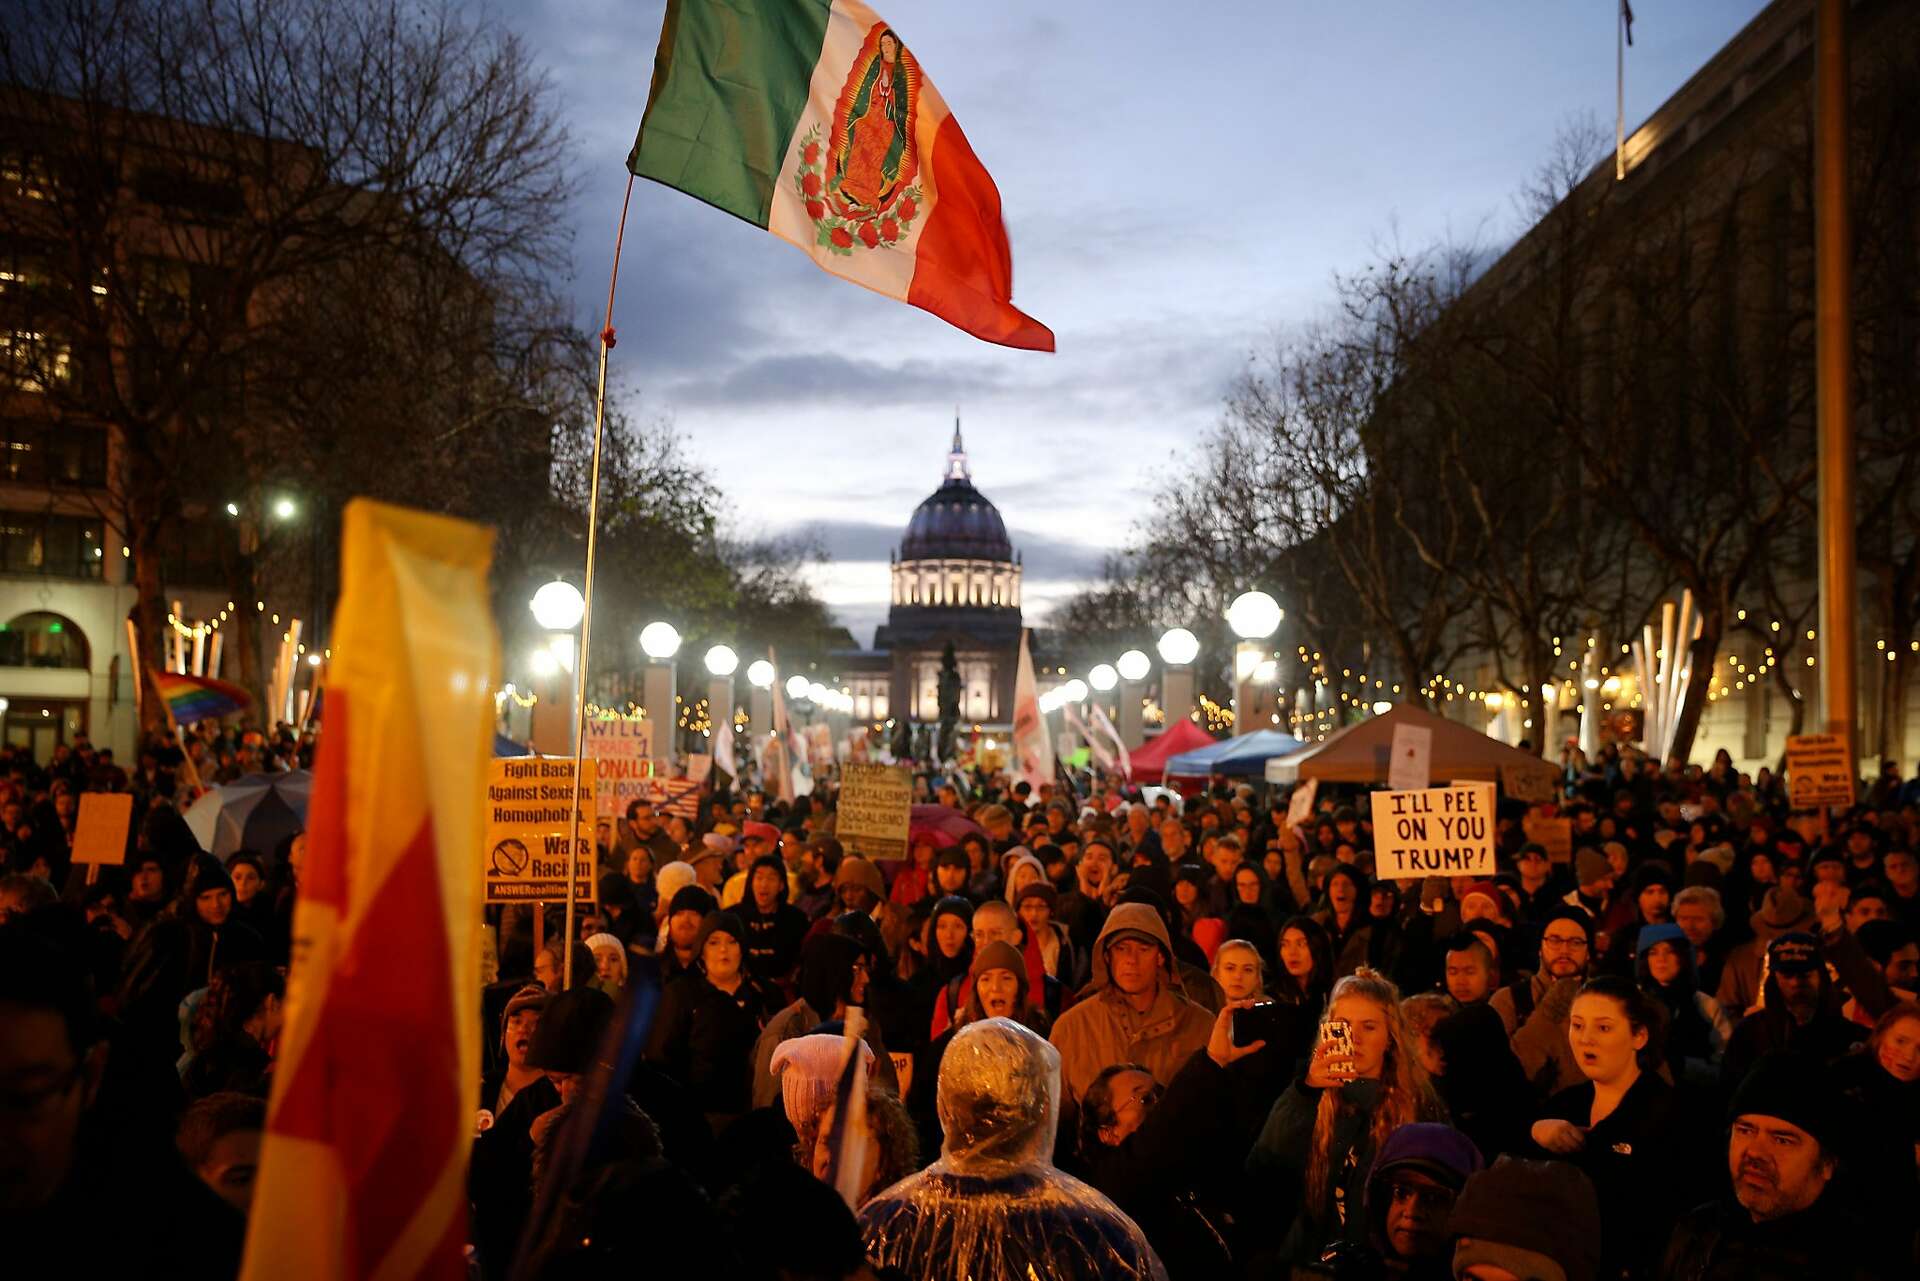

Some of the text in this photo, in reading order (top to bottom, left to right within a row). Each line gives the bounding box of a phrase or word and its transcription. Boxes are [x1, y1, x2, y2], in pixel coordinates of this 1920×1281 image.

[589, 720, 643, 736] WILL
[504, 763, 538, 778] Fight
[597, 759, 648, 778] ONALD
[488, 785, 538, 801] Against
[844, 786, 909, 801] CAPITALISMO
[1390, 792, 1477, 815] I'LL PEE
[494, 807, 586, 823] Homophoba,
[841, 809, 904, 826] SOCIALISMO
[1397, 817, 1485, 841] ON YOU
[544, 837, 580, 854] Wa
[1392, 848, 1487, 870] TRUMP!
[532, 859, 591, 877] Racim
